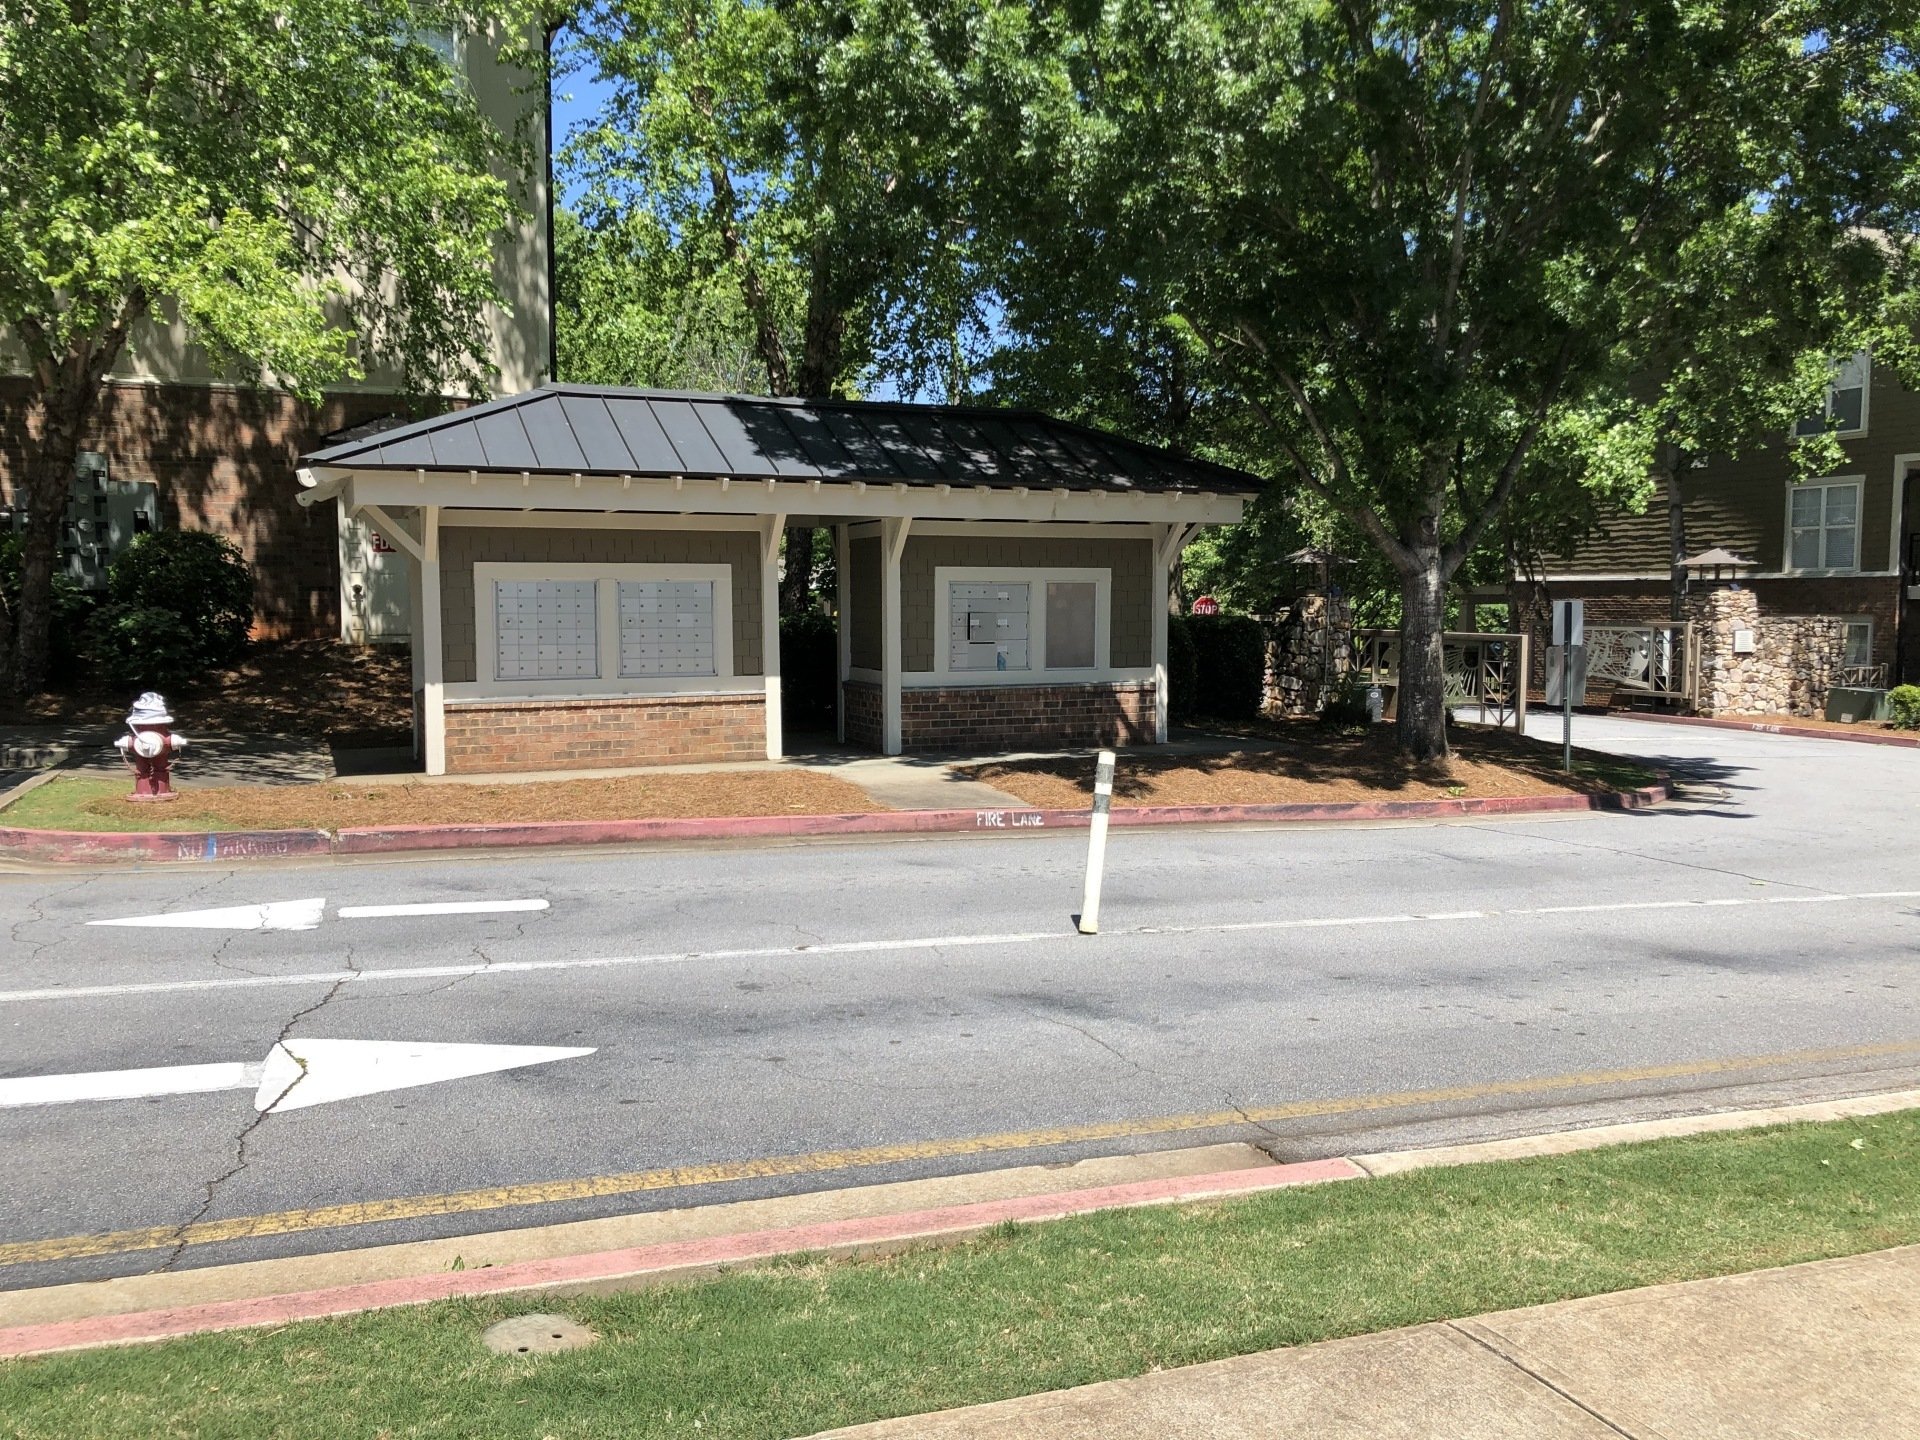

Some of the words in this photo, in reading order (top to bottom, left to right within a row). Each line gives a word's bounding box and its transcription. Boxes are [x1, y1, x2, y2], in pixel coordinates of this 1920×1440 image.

[372, 535, 396, 550] FD
[1195, 604, 1218, 615] STOP
[976, 811, 1006, 827] FIRE
[1011, 811, 1045, 827] LANE
